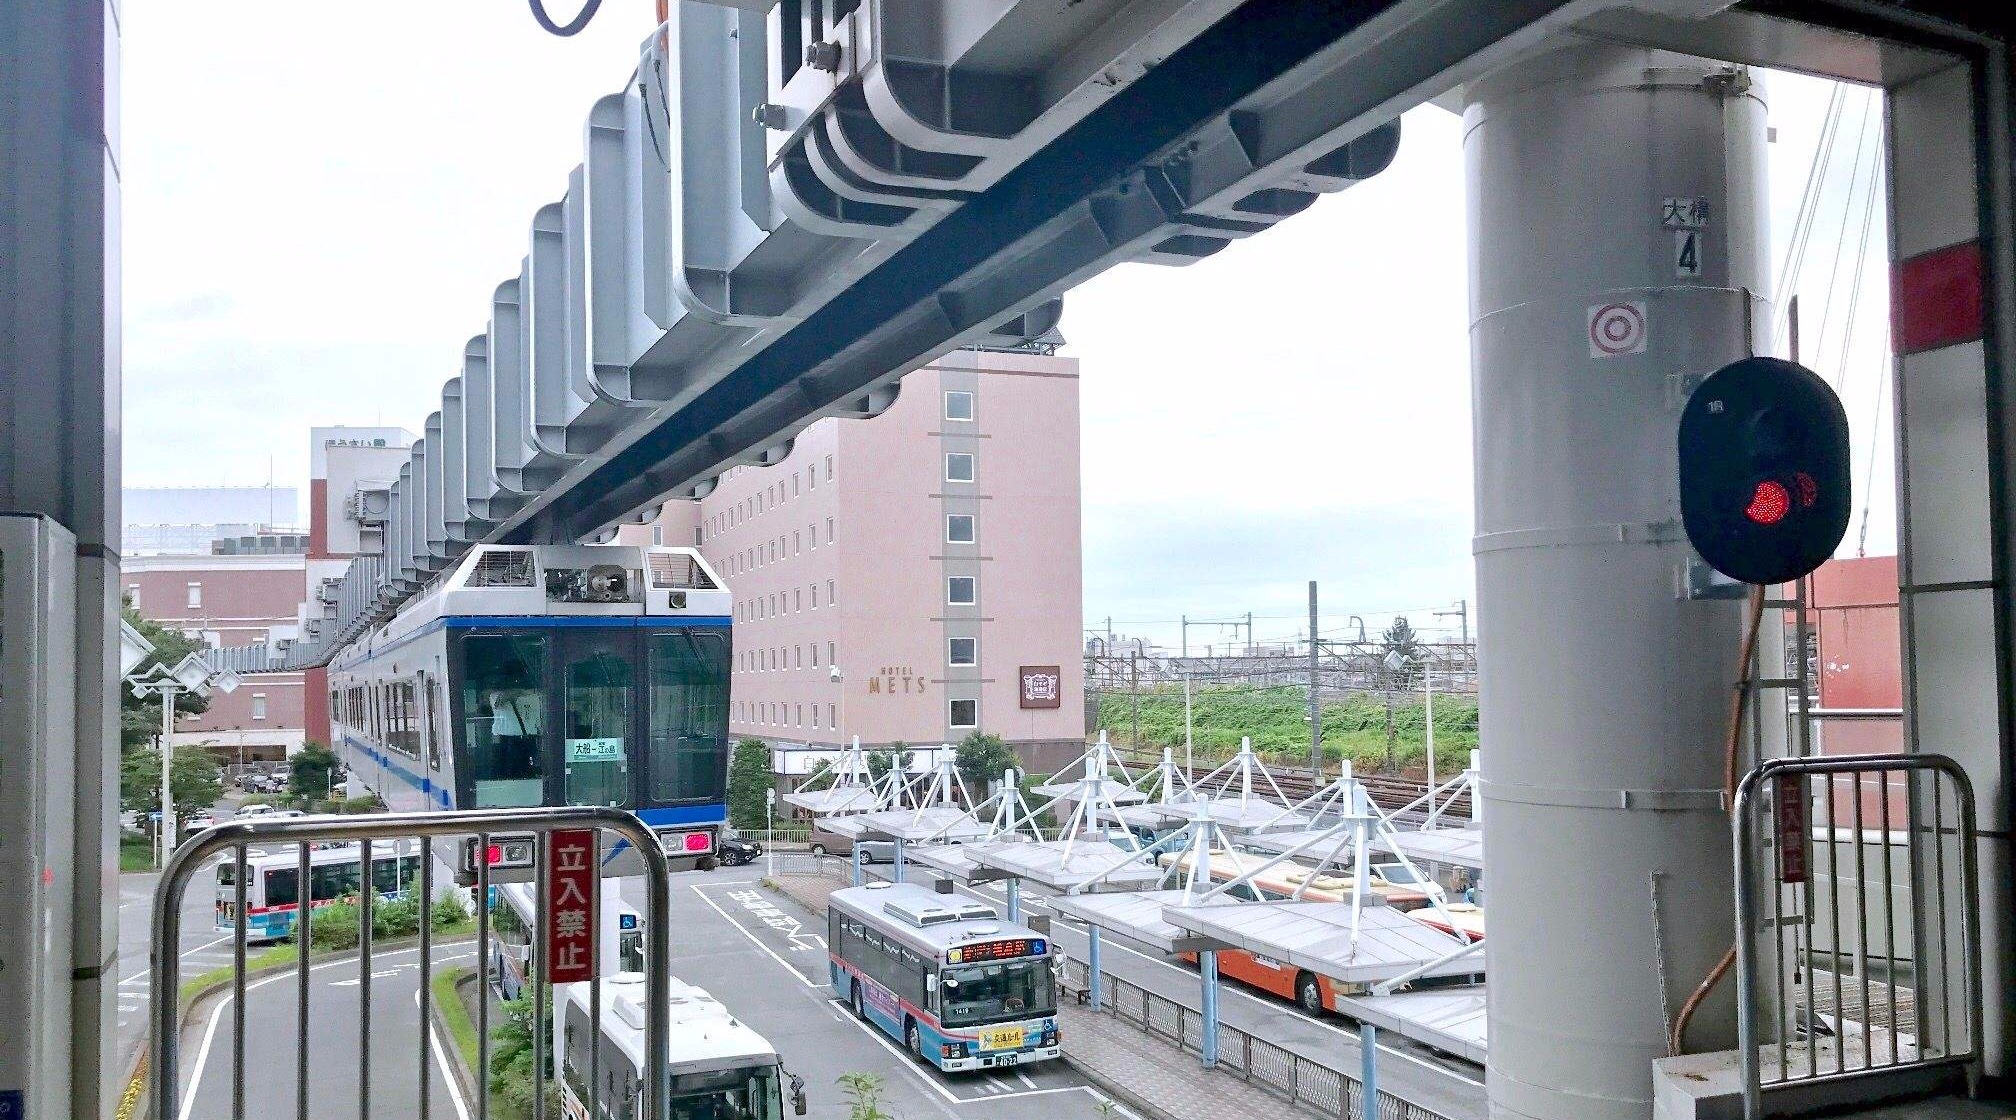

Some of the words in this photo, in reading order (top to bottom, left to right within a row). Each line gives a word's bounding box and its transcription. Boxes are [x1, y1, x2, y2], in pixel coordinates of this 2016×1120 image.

[1678, 232, 1698, 274] 4
[869, 676, 926, 694] METS
[880, 666, 913, 676] HOTEL
[556, 843, 586, 970] 立入禁止
